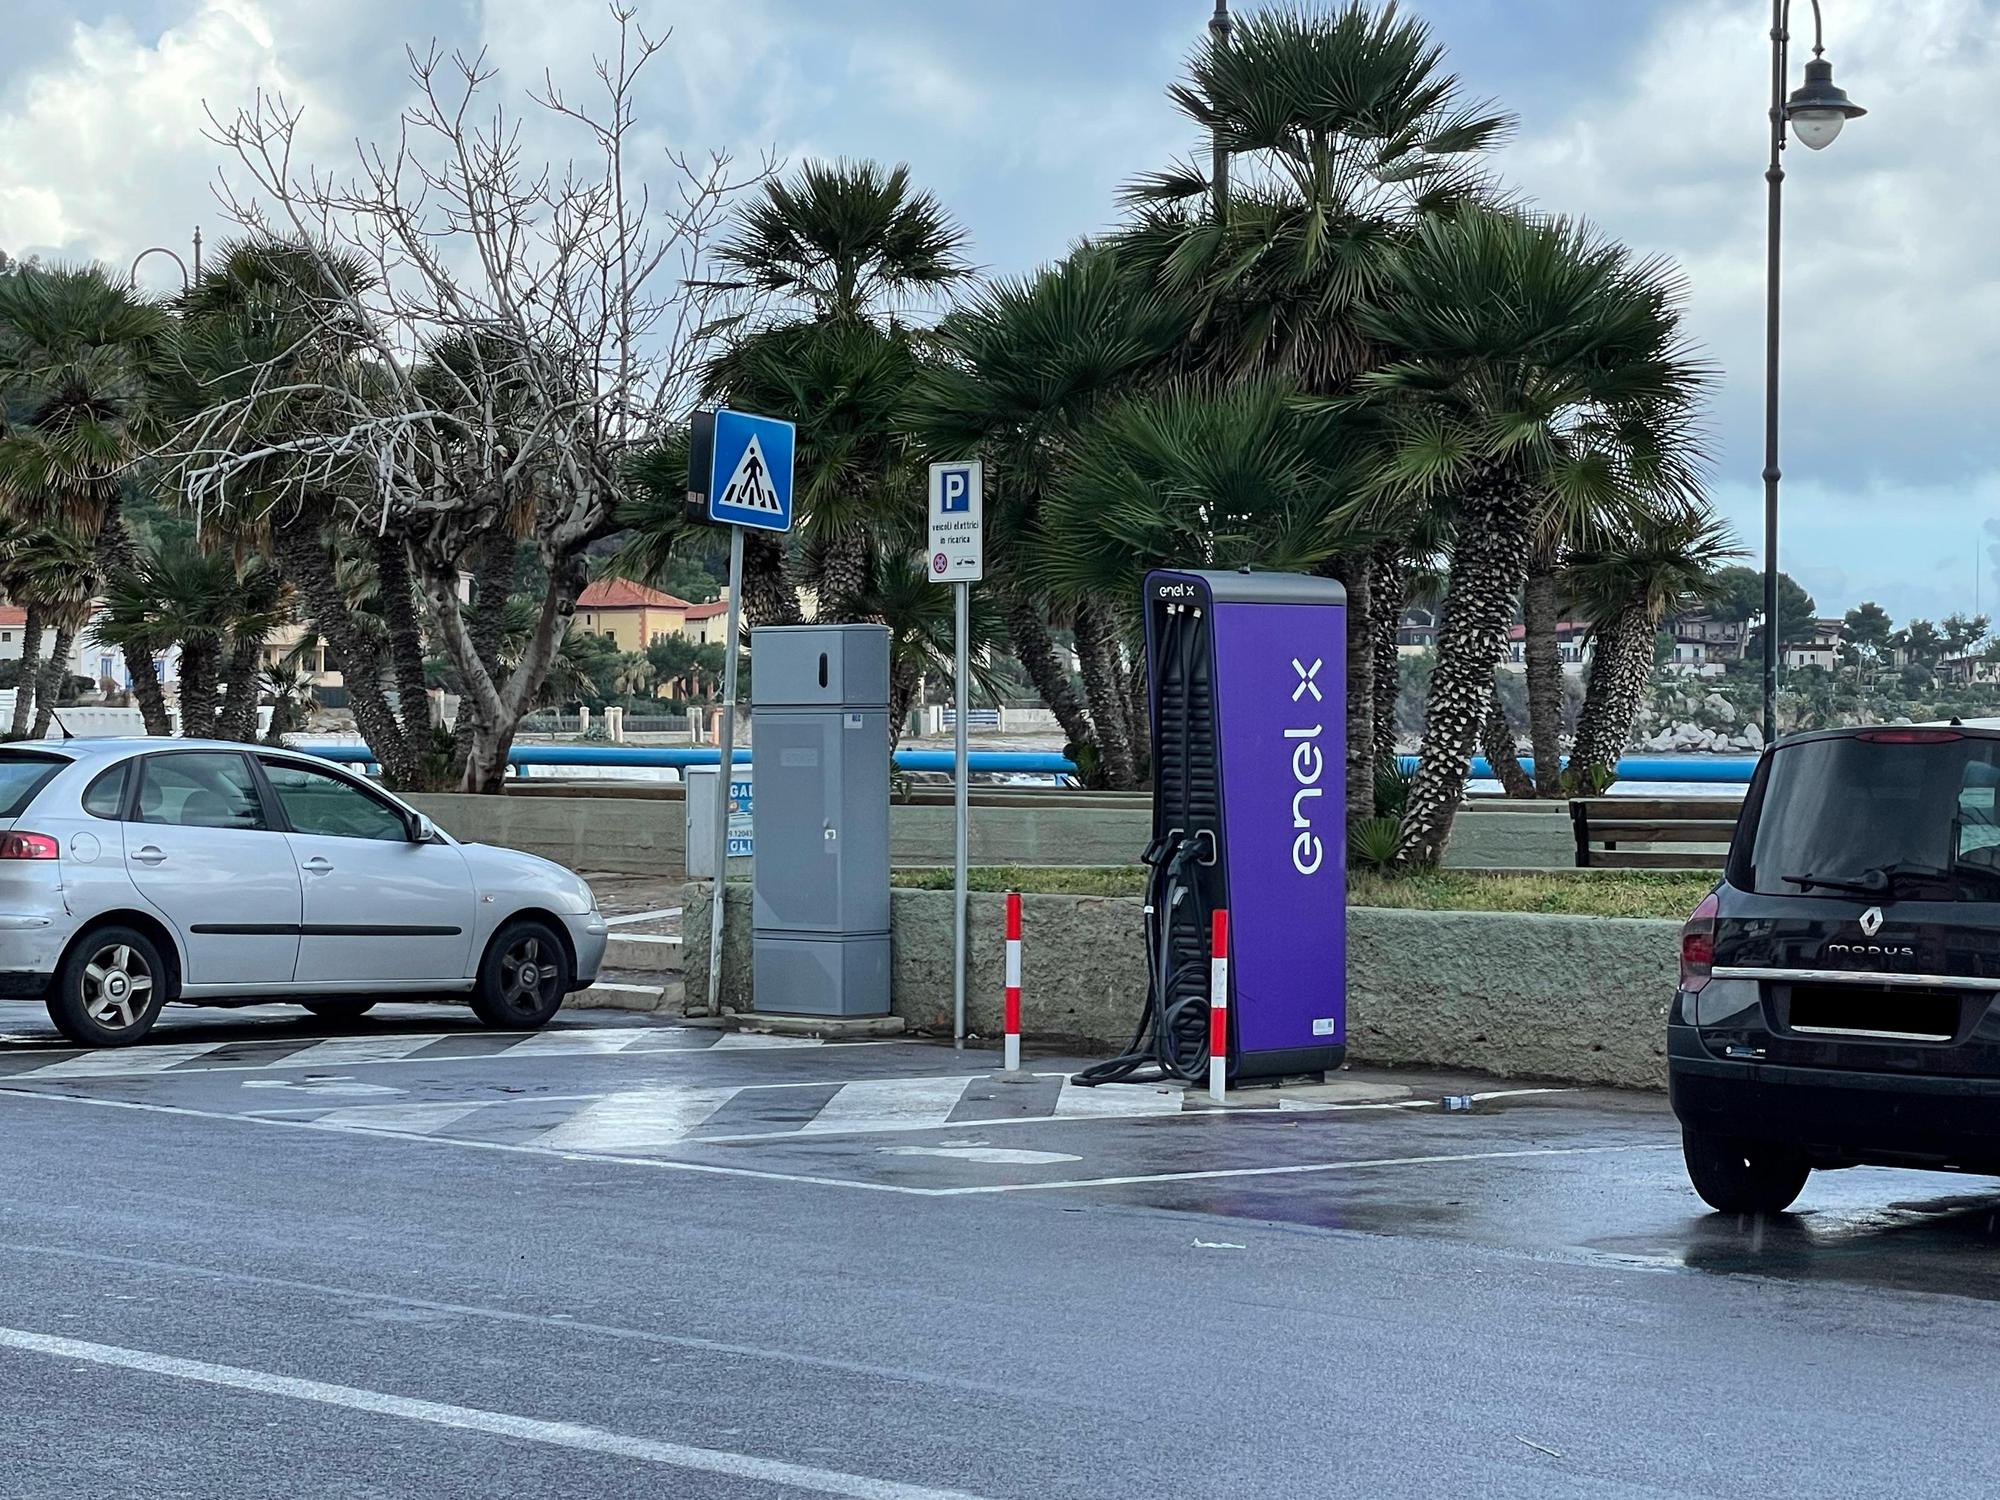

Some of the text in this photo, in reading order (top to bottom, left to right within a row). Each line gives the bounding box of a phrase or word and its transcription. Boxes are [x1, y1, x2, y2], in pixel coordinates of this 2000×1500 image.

[946, 474, 965, 509] P
[932, 520, 979, 531] veicoli elettrici
[940, 535, 970, 544] in ricarica
[1159, 583, 1184, 597] enel
[1284, 724, 1323, 875] enel
